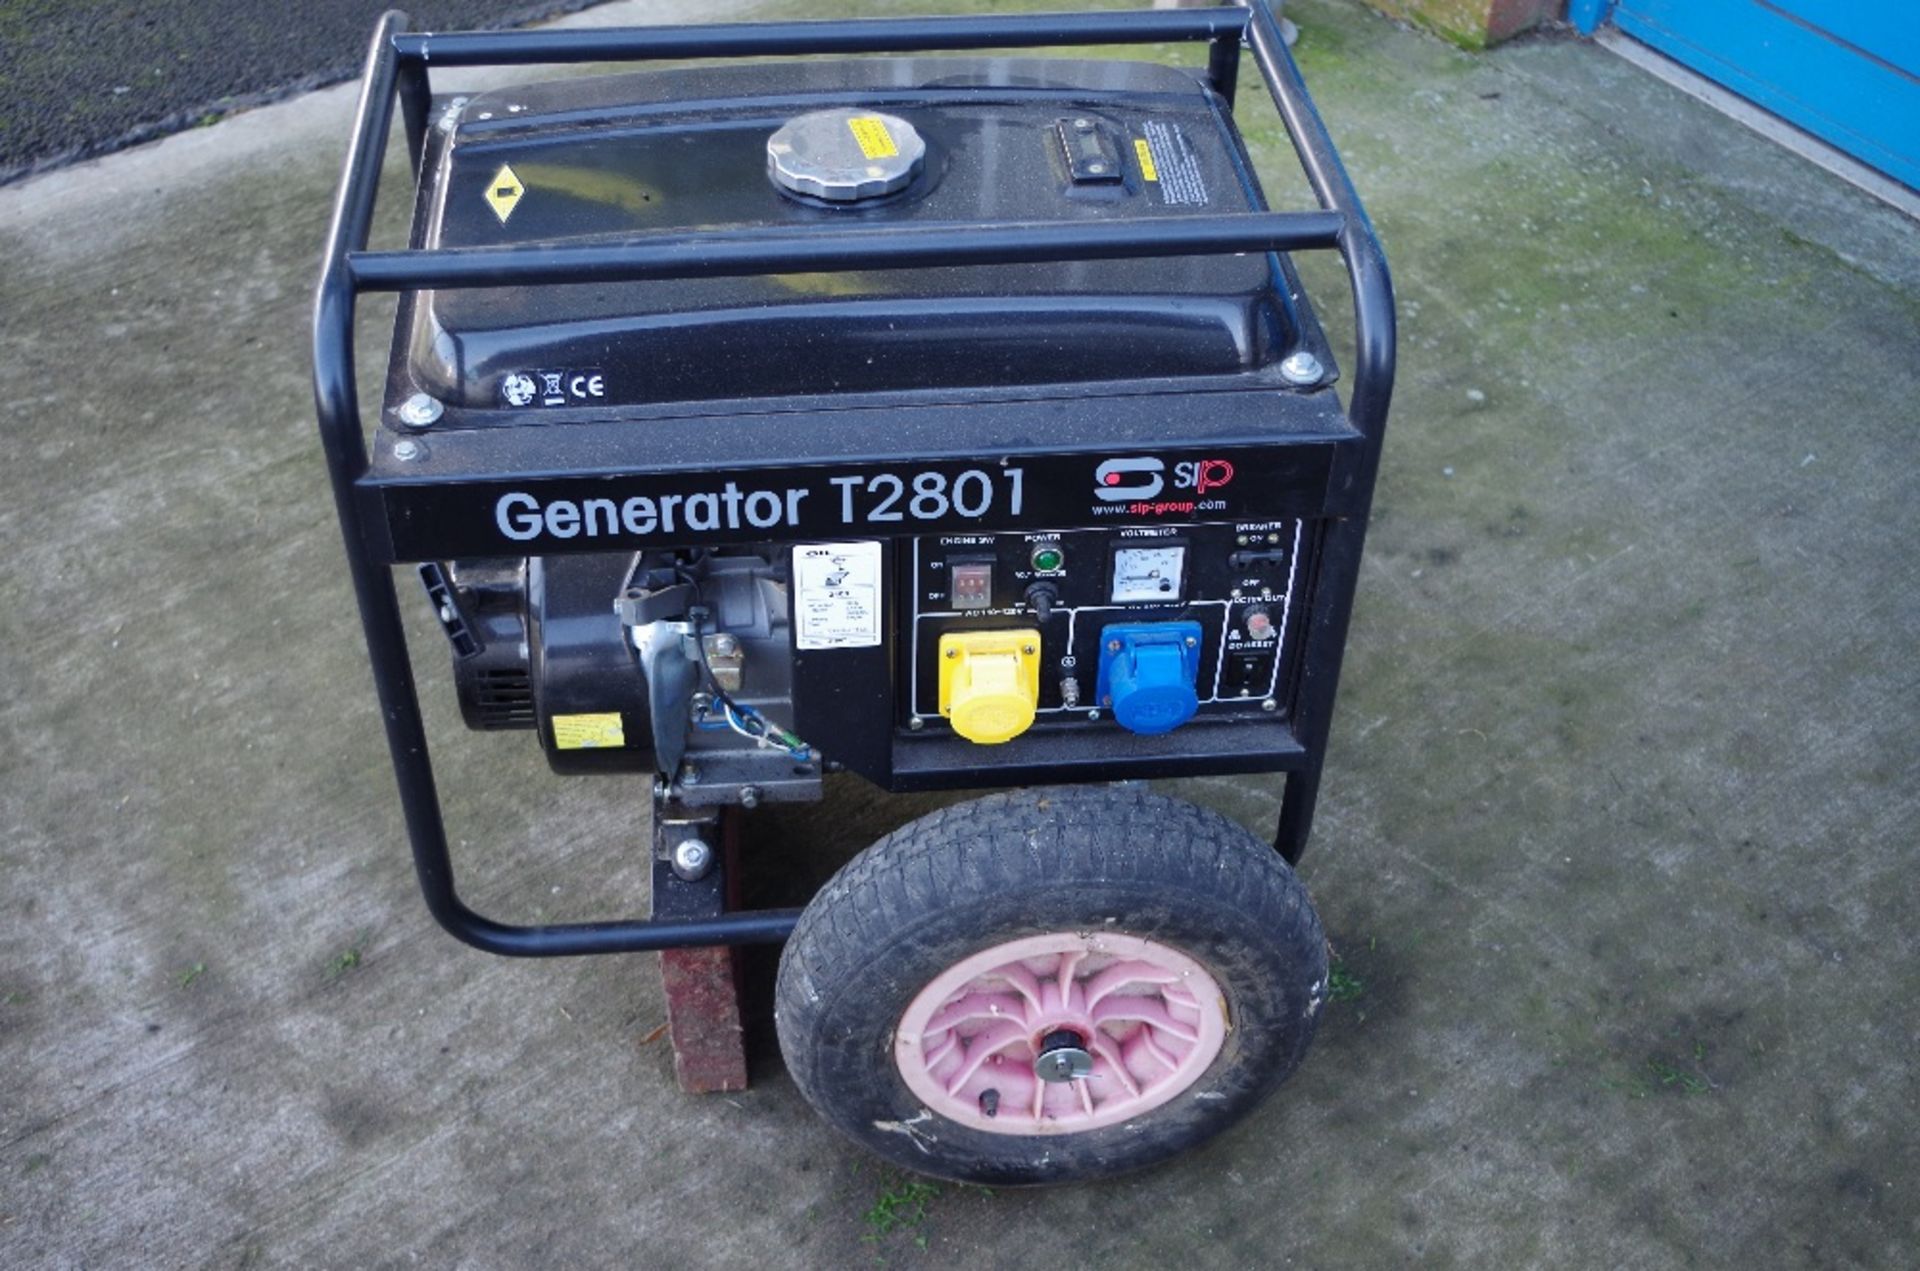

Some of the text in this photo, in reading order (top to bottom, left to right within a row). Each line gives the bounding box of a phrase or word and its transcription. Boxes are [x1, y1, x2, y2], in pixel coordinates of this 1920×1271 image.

[571, 376, 604, 398] CE
[496, 468, 1024, 541] Generator T2801
[1092, 500, 1227, 515] www.sip-group.com
[1024, 533, 1061, 542] POWER
